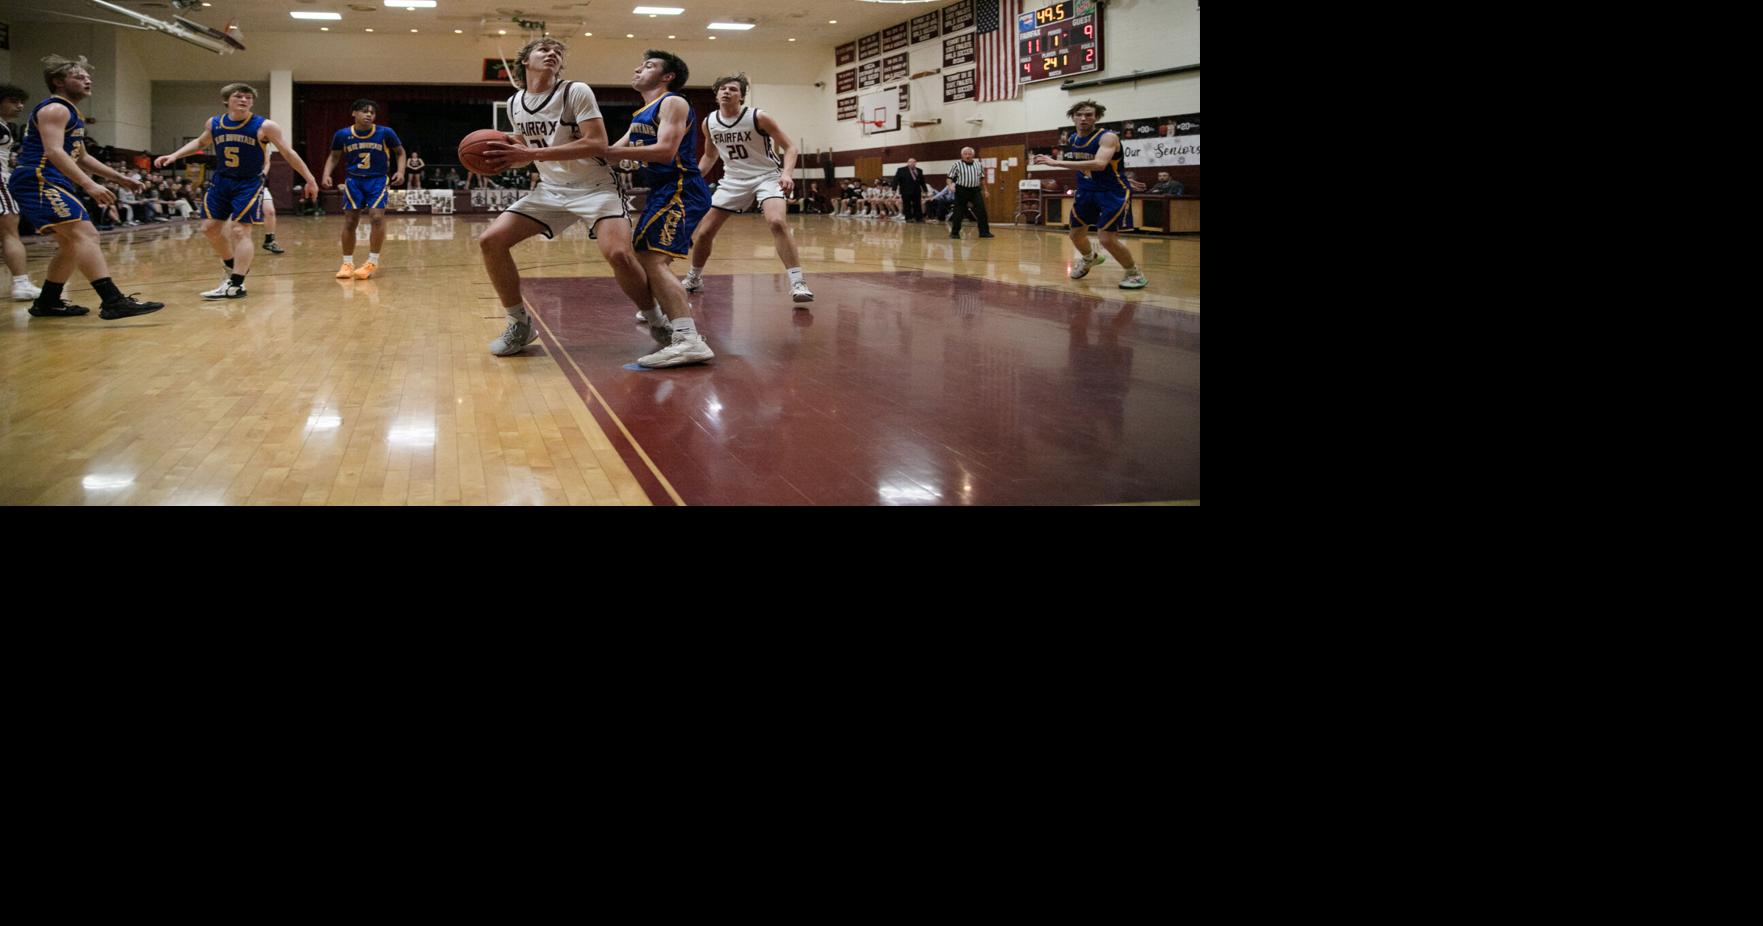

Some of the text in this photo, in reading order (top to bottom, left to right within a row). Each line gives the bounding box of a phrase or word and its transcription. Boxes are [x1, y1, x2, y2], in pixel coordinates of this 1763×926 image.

[1037, 4, 1064, 23] 49.5
[1072, 15, 1092, 26] GUEST
[1084, 25, 1092, 39] 9
[1028, 39, 1040, 54] 11
[1054, 36, 1058, 46] 1
[1044, 55, 1067, 70] 24 1
[1086, 49, 1093, 62] 2
[1024, 63, 1030, 72] 4
[714, 131, 751, 143] FAIRFAX
[224, 146, 240, 167] 5
[726, 144, 748, 160] 20
[1125, 146, 1141, 157] Our
[357, 152, 370, 169] 3
